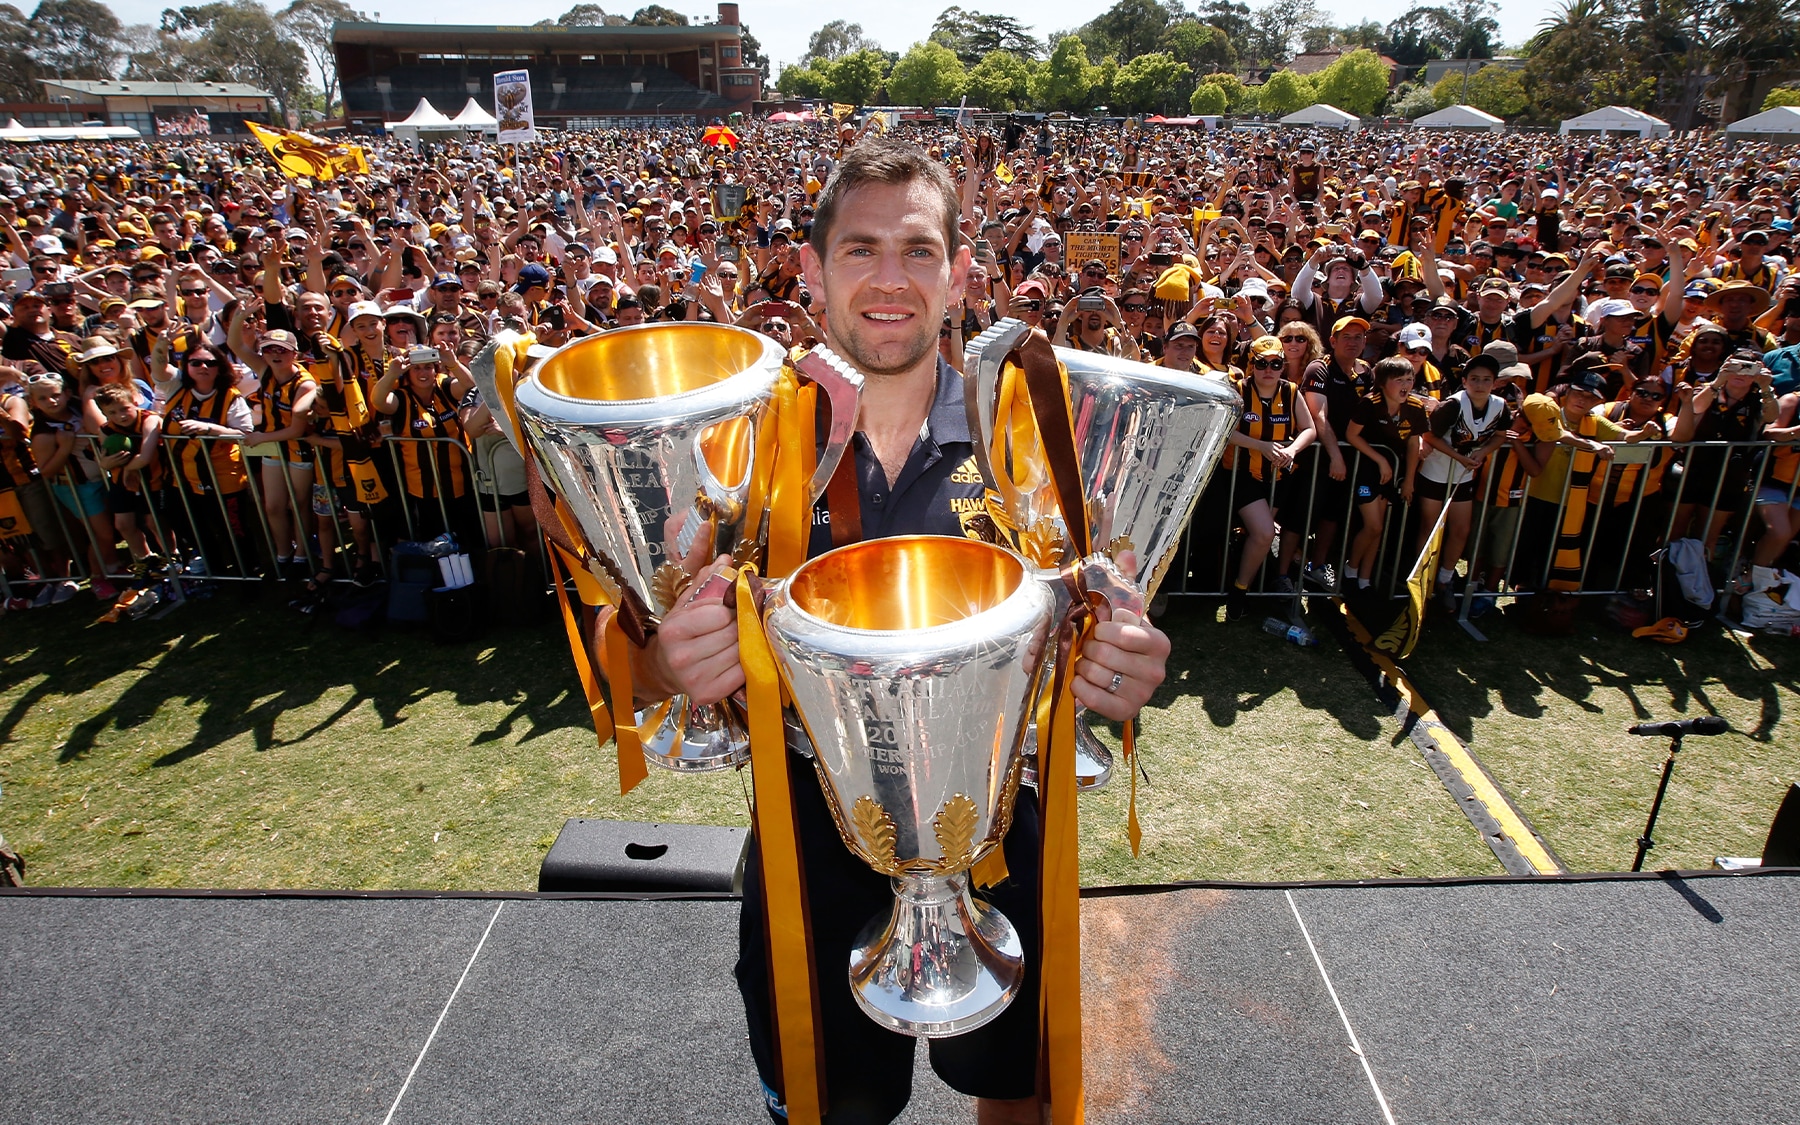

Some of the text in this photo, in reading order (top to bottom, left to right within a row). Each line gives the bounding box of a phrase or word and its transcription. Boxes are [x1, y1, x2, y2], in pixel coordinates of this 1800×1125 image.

[512, 73, 525, 81] Sun
[1068, 258, 1117, 270] HAKS
[1245, 413, 1259, 421] AFL
[950, 497, 987, 513] HAW
